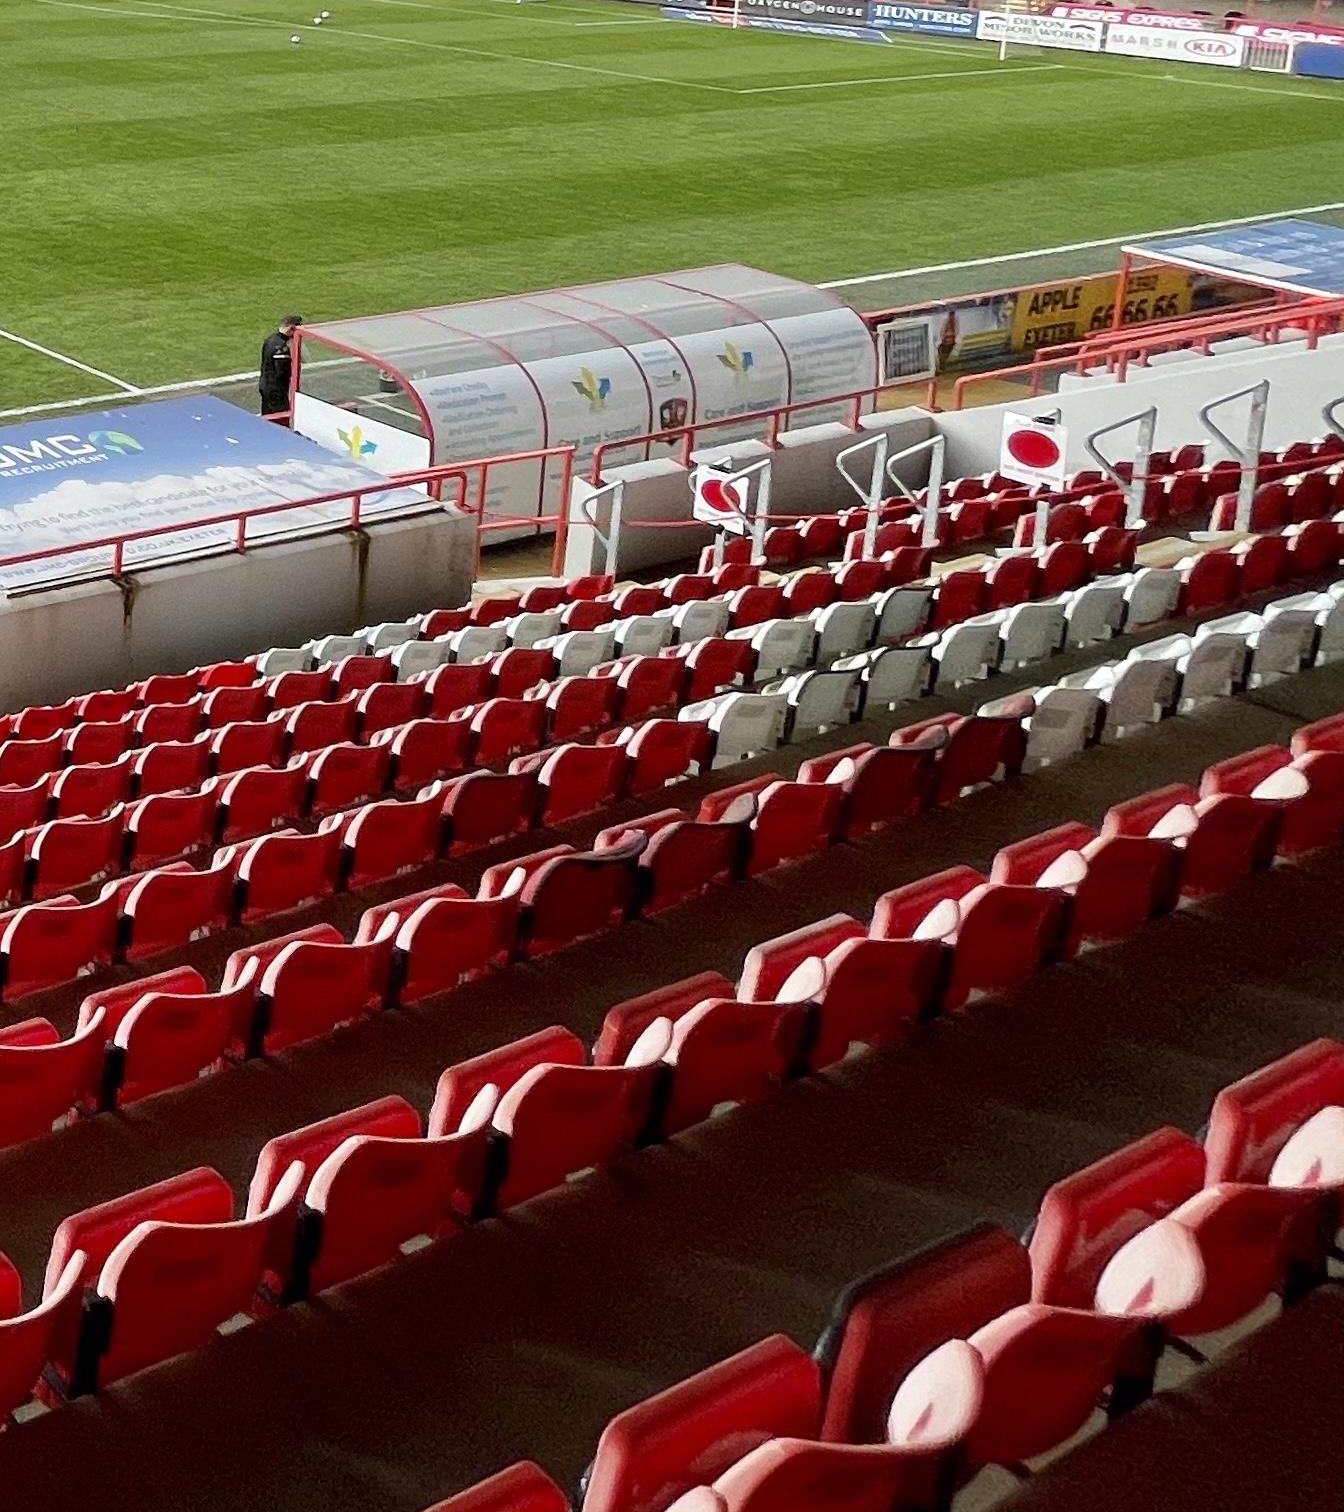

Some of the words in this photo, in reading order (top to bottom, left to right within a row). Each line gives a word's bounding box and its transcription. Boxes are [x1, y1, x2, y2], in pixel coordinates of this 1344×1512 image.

[816, 4, 864, 17] HOUSE
[874, 4, 975, 27] HUNTERS
[1069, 7, 1123, 23] SIGNS
[1013, 17, 1066, 30] DEVON
[1039, 28, 1097, 41] WORKS
[1193, 43, 1229, 57] KIA
[1028, 286, 1082, 317] APPLE
[1024, 321, 1077, 345] EXETER
